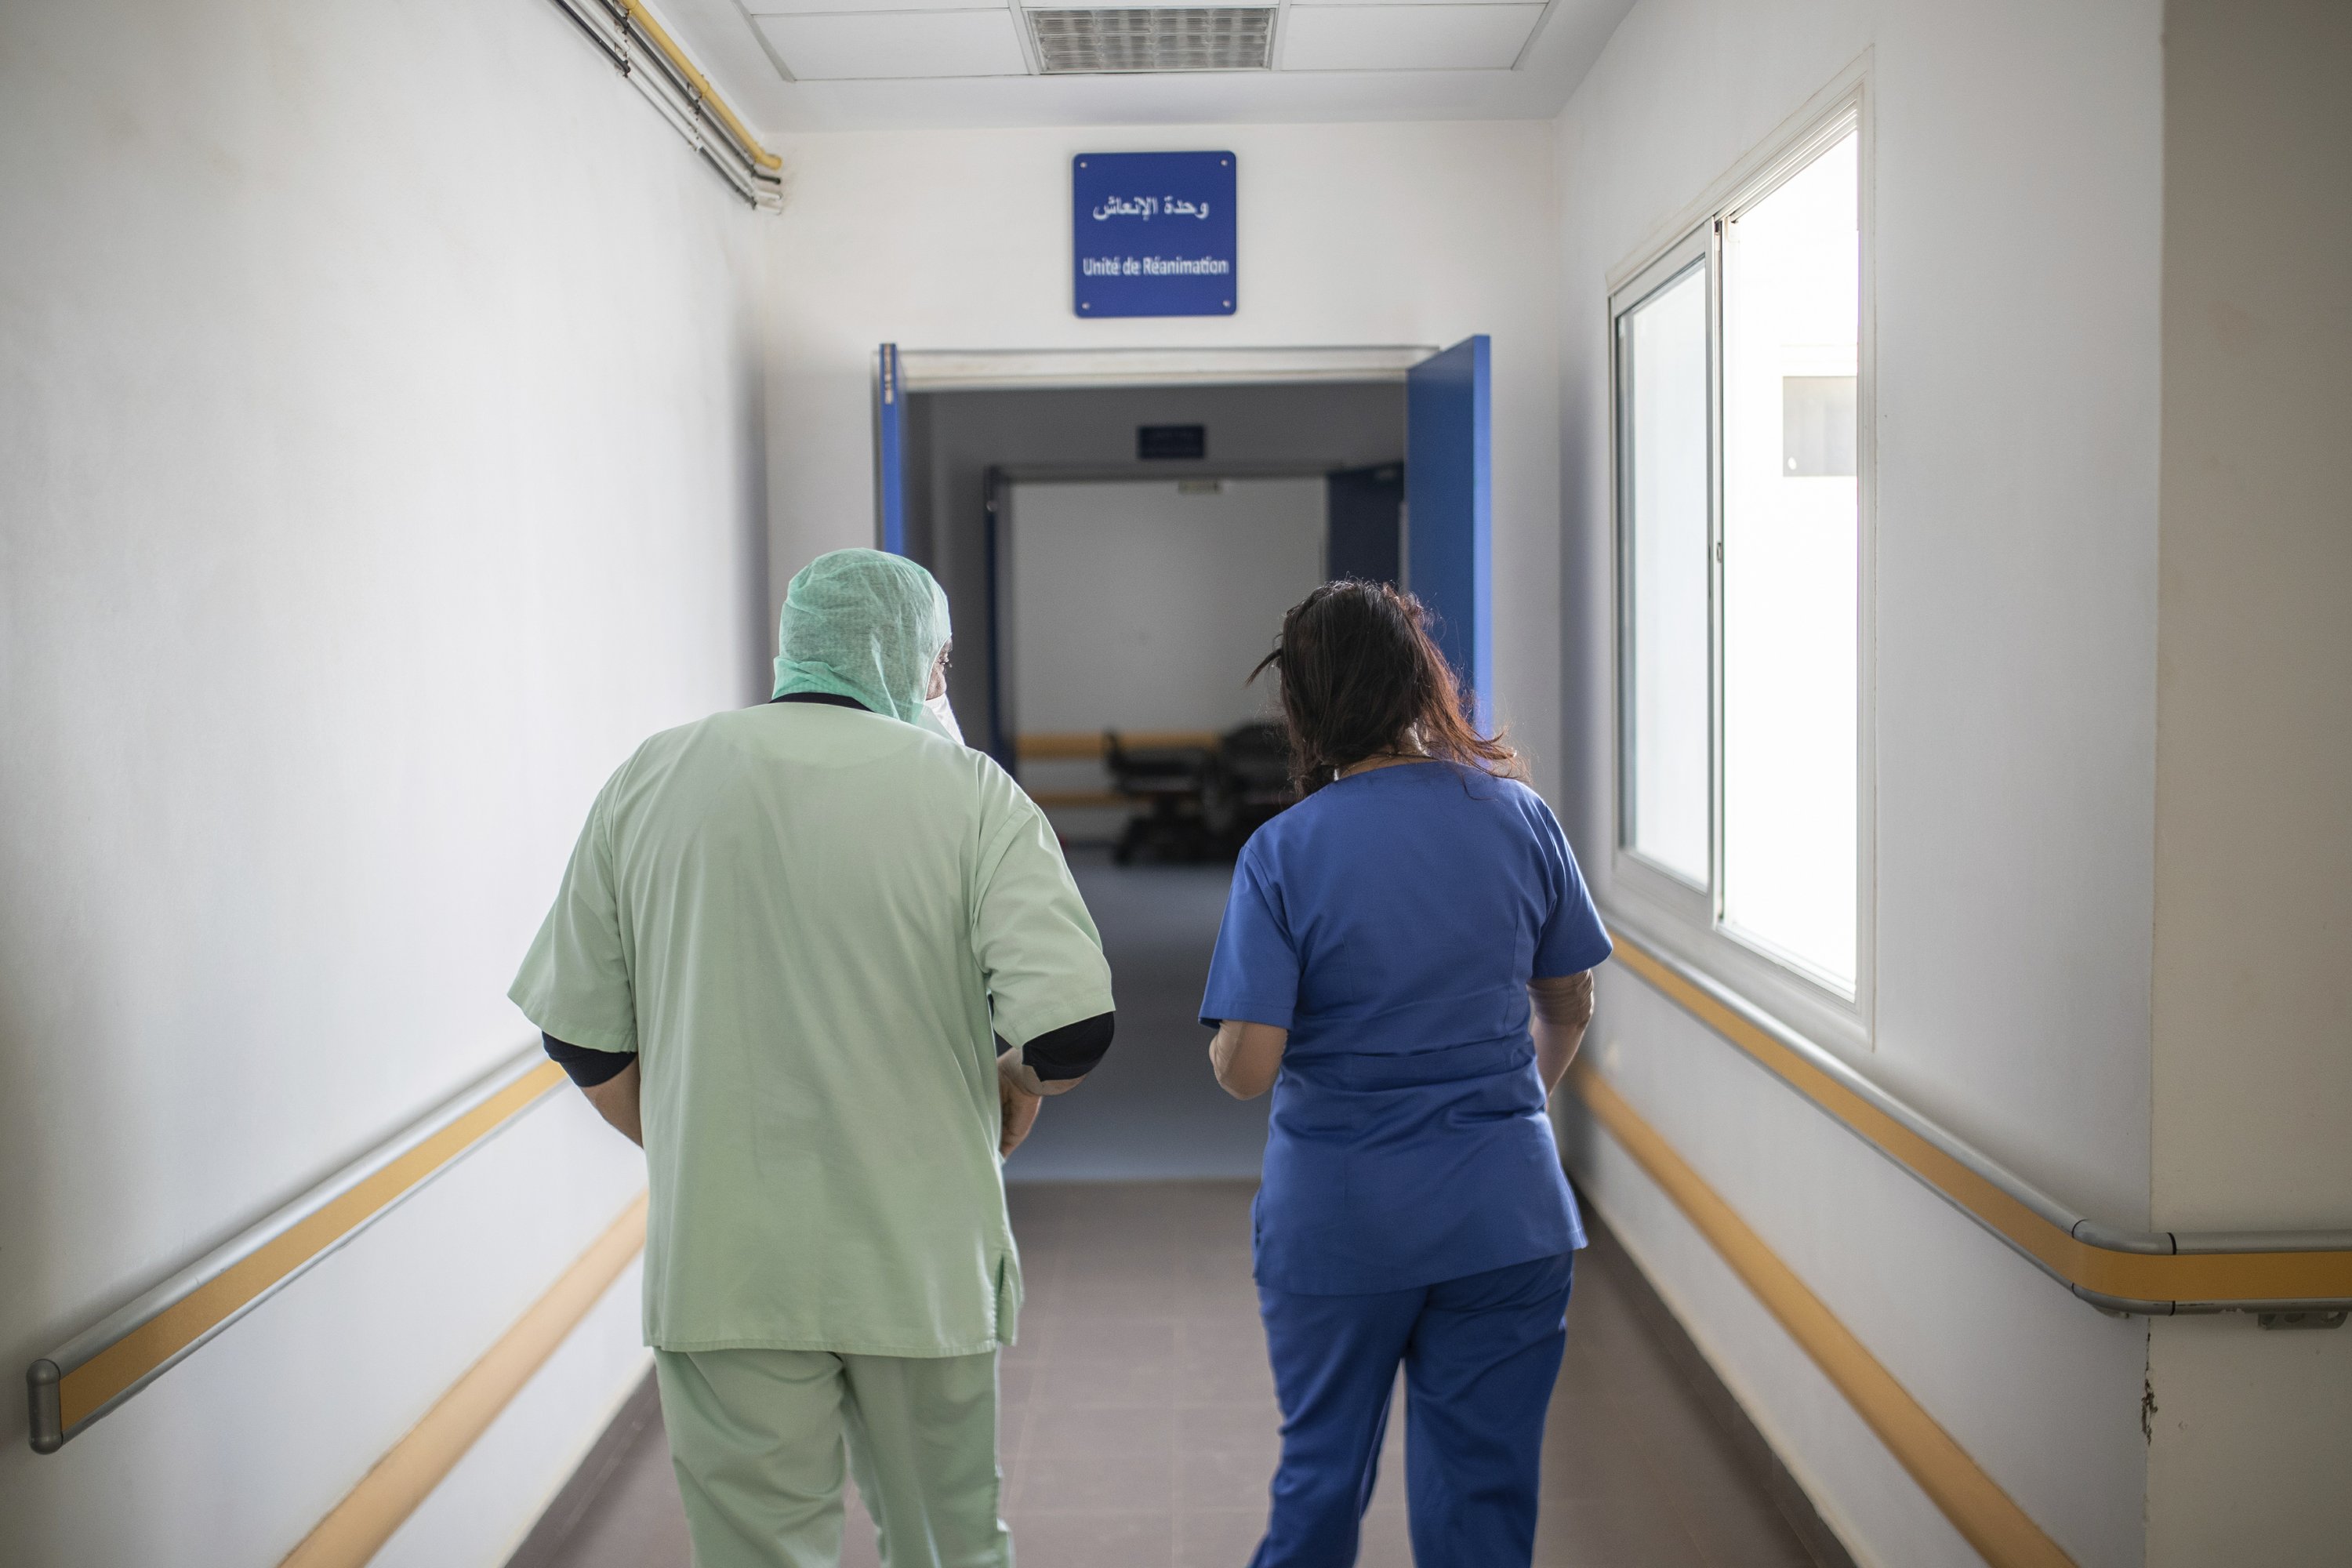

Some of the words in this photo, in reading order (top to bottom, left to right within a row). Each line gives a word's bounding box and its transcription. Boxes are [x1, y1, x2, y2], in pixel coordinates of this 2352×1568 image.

[1093, 195, 1158, 221] الإنعاش
[1163, 195, 1209, 220] وحدة
[1083, 256, 1120, 275] Unité
[1122, 256, 1140, 275] de
[1142, 256, 1229, 274] Réanimation
